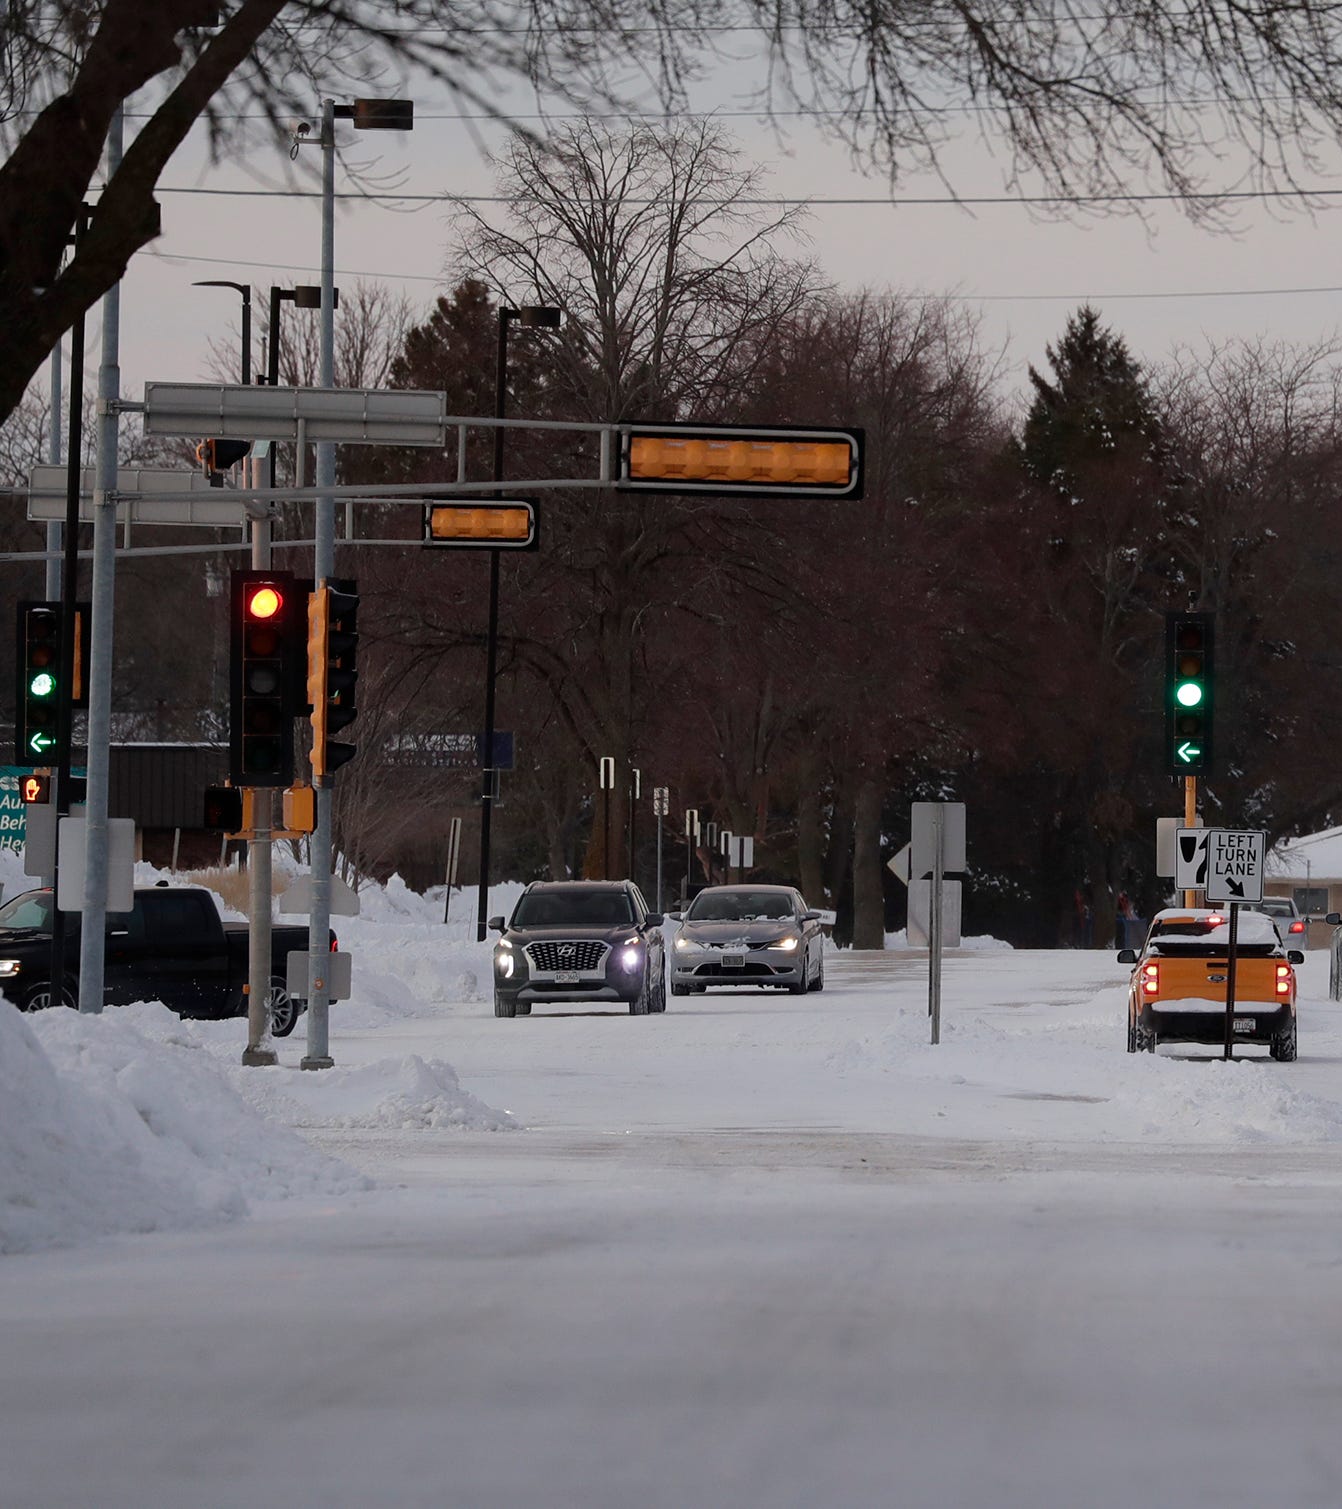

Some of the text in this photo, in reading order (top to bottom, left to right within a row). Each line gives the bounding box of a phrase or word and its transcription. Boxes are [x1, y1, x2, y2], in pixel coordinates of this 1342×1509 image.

[1218, 834, 1254, 848] LEFT
[1216, 848, 1256, 862] TURN
[1215, 862, 1255, 876] LANE
